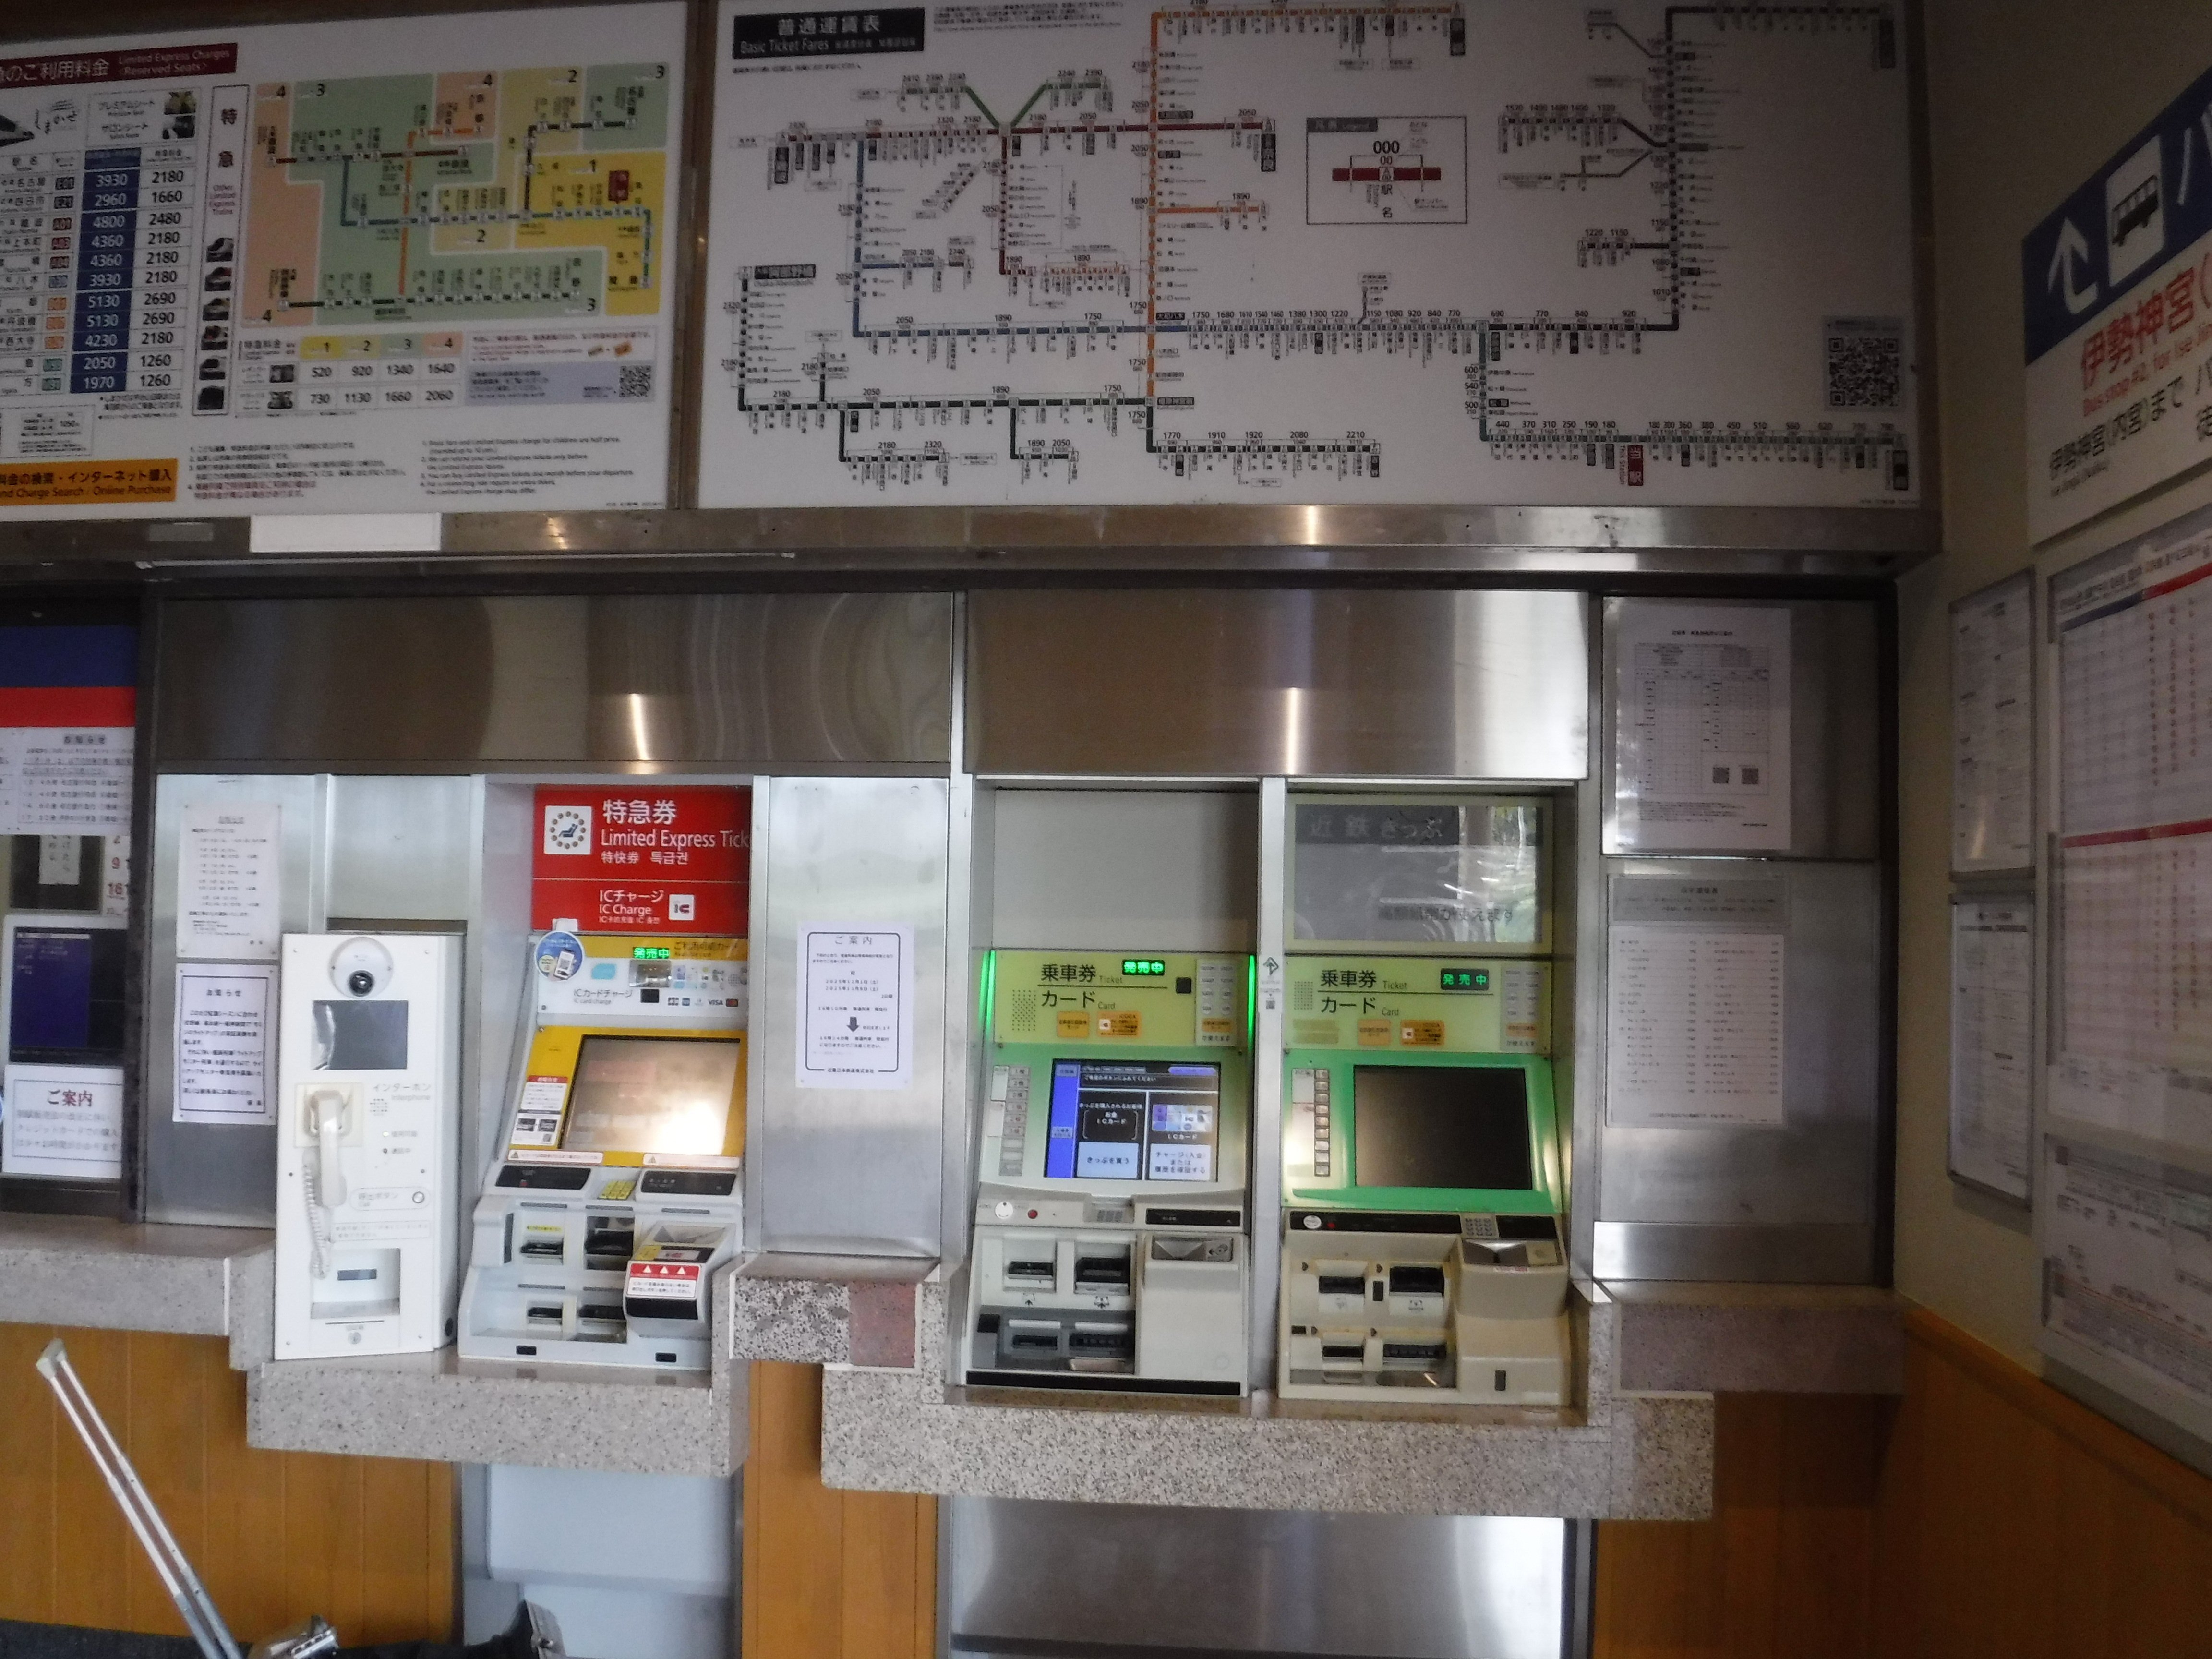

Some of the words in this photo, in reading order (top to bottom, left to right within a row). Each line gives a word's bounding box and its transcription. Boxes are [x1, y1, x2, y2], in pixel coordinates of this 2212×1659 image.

[769, 39, 799, 52] Ticket
[802, 38, 829, 50] Fares
[0, 58, 110, 83] のご利用料金
[1373, 140, 1400, 154] 000
[1380, 156, 1393, 165] 00
[97, 174, 128, 186] 3930
[152, 171, 183, 183] 2180
[96, 194, 126, 206] 2960
[152, 191, 182, 203] 1660
[94, 215, 125, 228] 4800
[149, 213, 181, 225] 2480
[92, 236, 123, 248] 4360
[148, 232, 180, 244] 2180
[90, 255, 122, 267] 4360
[146, 252, 179, 264] 2180
[90, 274, 121, 286] 3930
[145, 271, 178, 283] 2180
[88, 296, 120, 308] 5130
[144, 293, 176, 305] 2690
[87, 315, 118, 327] 5130
[143, 313, 175, 325] 2690
[85, 334, 118, 346] 4230
[141, 332, 173, 344] 2180
[84, 356, 116, 369] 2050
[141, 354, 171, 366] 1260
[311, 366, 332, 378] 520
[351, 365, 373, 376] 920
[386, 364, 414, 375] 1340
[427, 362, 455, 374] 1640
[83, 376, 115, 388] 1970
[140, 374, 171, 386] 1260
[310, 393, 330, 404] 730
[345, 391, 371, 403] 1130
[385, 391, 411, 403] 1660
[426, 389, 454, 401] 2060
[602, 799, 677, 825] 特急券
[601, 828, 657, 847] Limited
[661, 829, 716, 852] Express
[601, 850, 640, 864] 特快券
[599, 889, 664, 903] ICチャージ
[599, 904, 613, 914] IC
[613, 904, 652, 916] Charge
[835, 936, 872, 945] ご案内
[633, 947, 670, 959] 発売中
[1041, 963, 1096, 983] 乗車券
[1123, 961, 1164, 973] 発売中
[1099, 976, 1123, 984] Ticket
[1321, 970, 1377, 988] 乗車券
[1382, 981, 1407, 990] Ticket
[1443, 974, 1488, 986] 発売中
[574, 989, 633, 998] ICカードチャージ
[1041, 990, 1096, 1008] カード
[1321, 996, 1376, 1014] カード
[1382, 1008, 1399, 1016] Card
[373, 1083, 431, 1092] インターホン
[47, 1089, 93, 1107] ご案内
